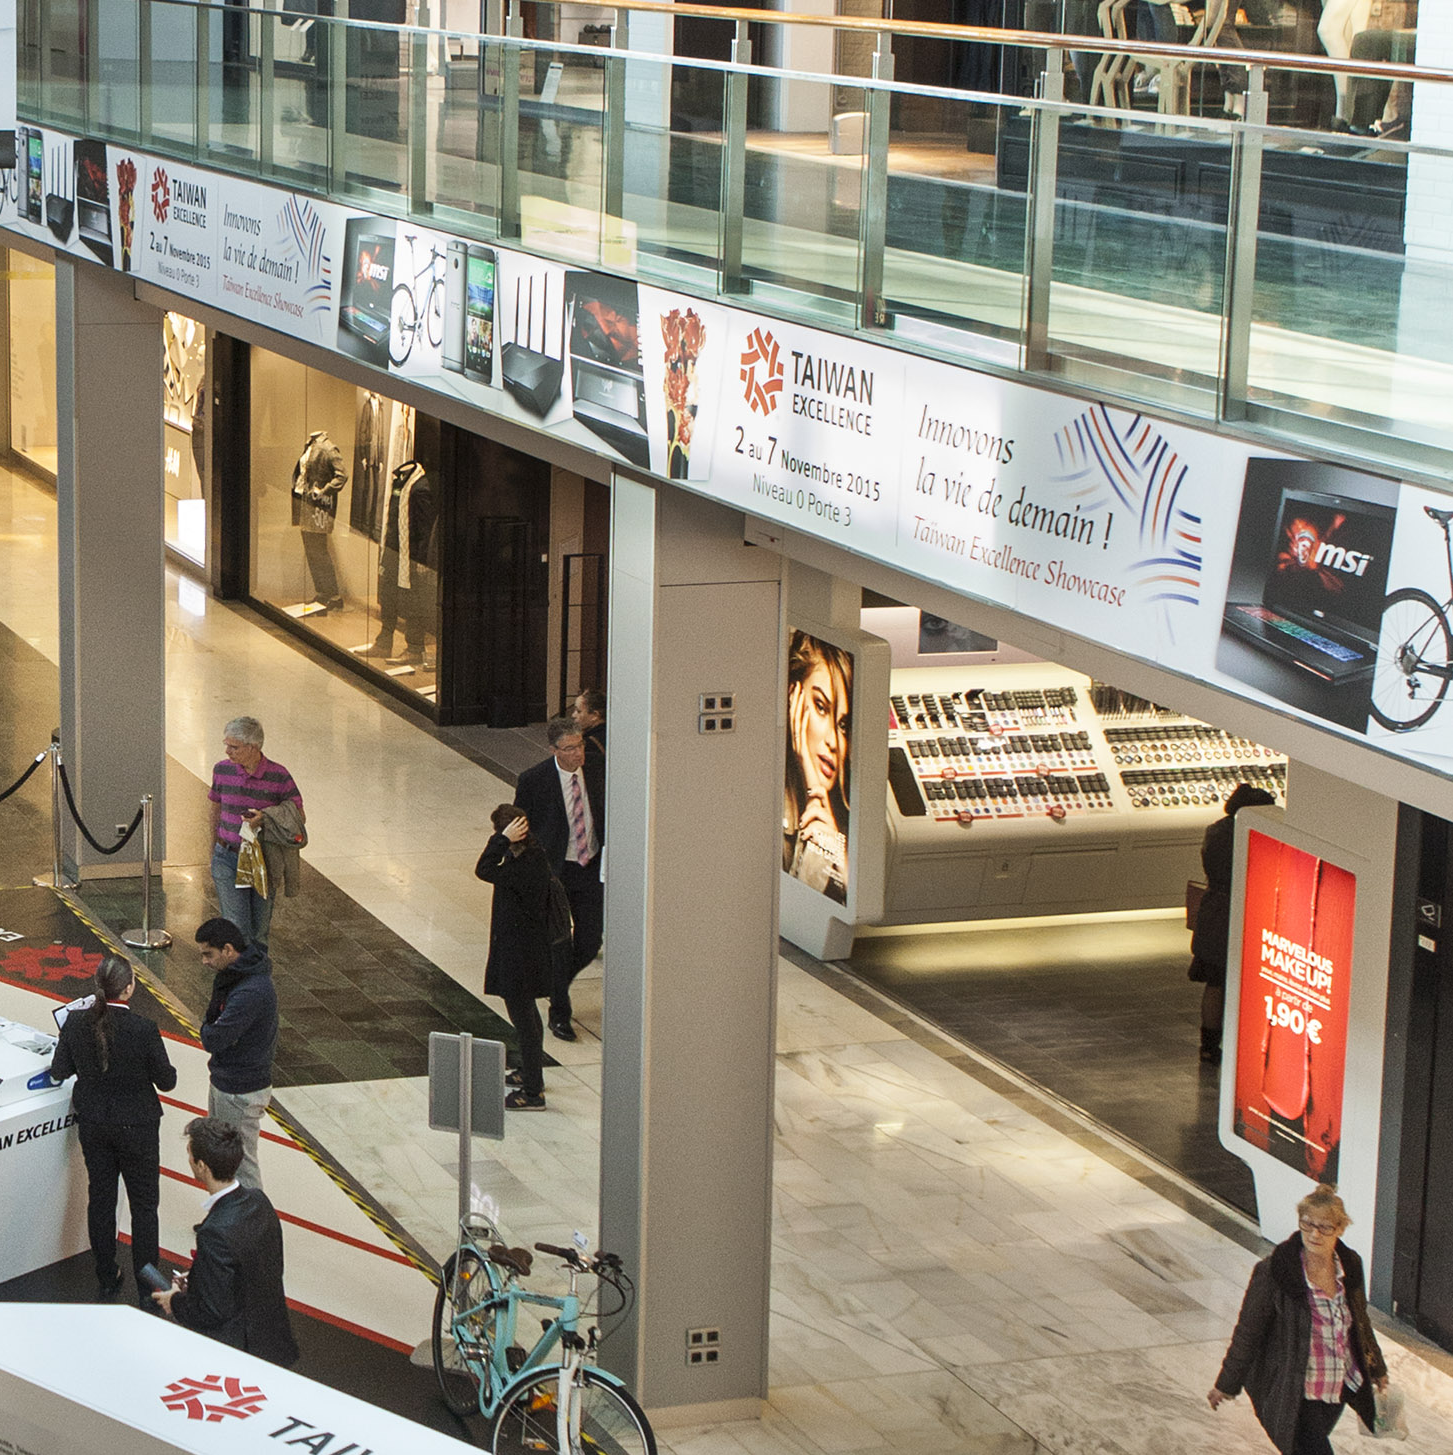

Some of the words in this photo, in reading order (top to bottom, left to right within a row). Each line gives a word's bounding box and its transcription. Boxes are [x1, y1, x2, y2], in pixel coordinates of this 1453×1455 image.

[172, 179, 207, 209] TAIWAN
[173, 206, 207, 229] EXCELLENCE
[223, 203, 261, 236] Innovons
[149, 231, 155, 250] 2
[163, 236, 168, 255] 7
[169, 244, 196, 265] Novembre
[196, 252, 210, 270] 2015
[223, 236, 232, 262] la
[234, 243, 245, 267] vie
[247, 245, 257, 270] de
[258, 248, 292, 283] demain
[244, 282, 273, 306] Excellence
[274, 292, 305, 318] Showcase
[791, 350, 874, 406] TAIWAN
[792, 393, 872, 436] EXCELLENCE
[918, 404, 1014, 465] Innovons
[735, 426, 744, 454] 2
[748, 443, 763, 461] au
[768, 436, 778, 465] 7
[781, 449, 843, 489] Novembre
[846, 472, 880, 502] 2015
[753, 473, 793, 505] Niveau
[808, 492, 840, 522] Porte
[843, 506, 852, 527] 3
[916, 456, 936, 495] la
[944, 472, 971, 508] vie
[978, 478, 1003, 518] de
[1008, 485, 1095, 546] demain
[1103, 512, 1114, 550] !
[913, 515, 965, 555] Taïwan
[970, 535, 1040, 580] Excellence
[1044, 560, 1126, 607] Showcase
[1314, 541, 1371, 577] msi
[1262, 928, 1334, 975] MARVELOUS
[1264, 995, 1305, 1035] 1,90
[1306, 1019, 1323, 1045] €
